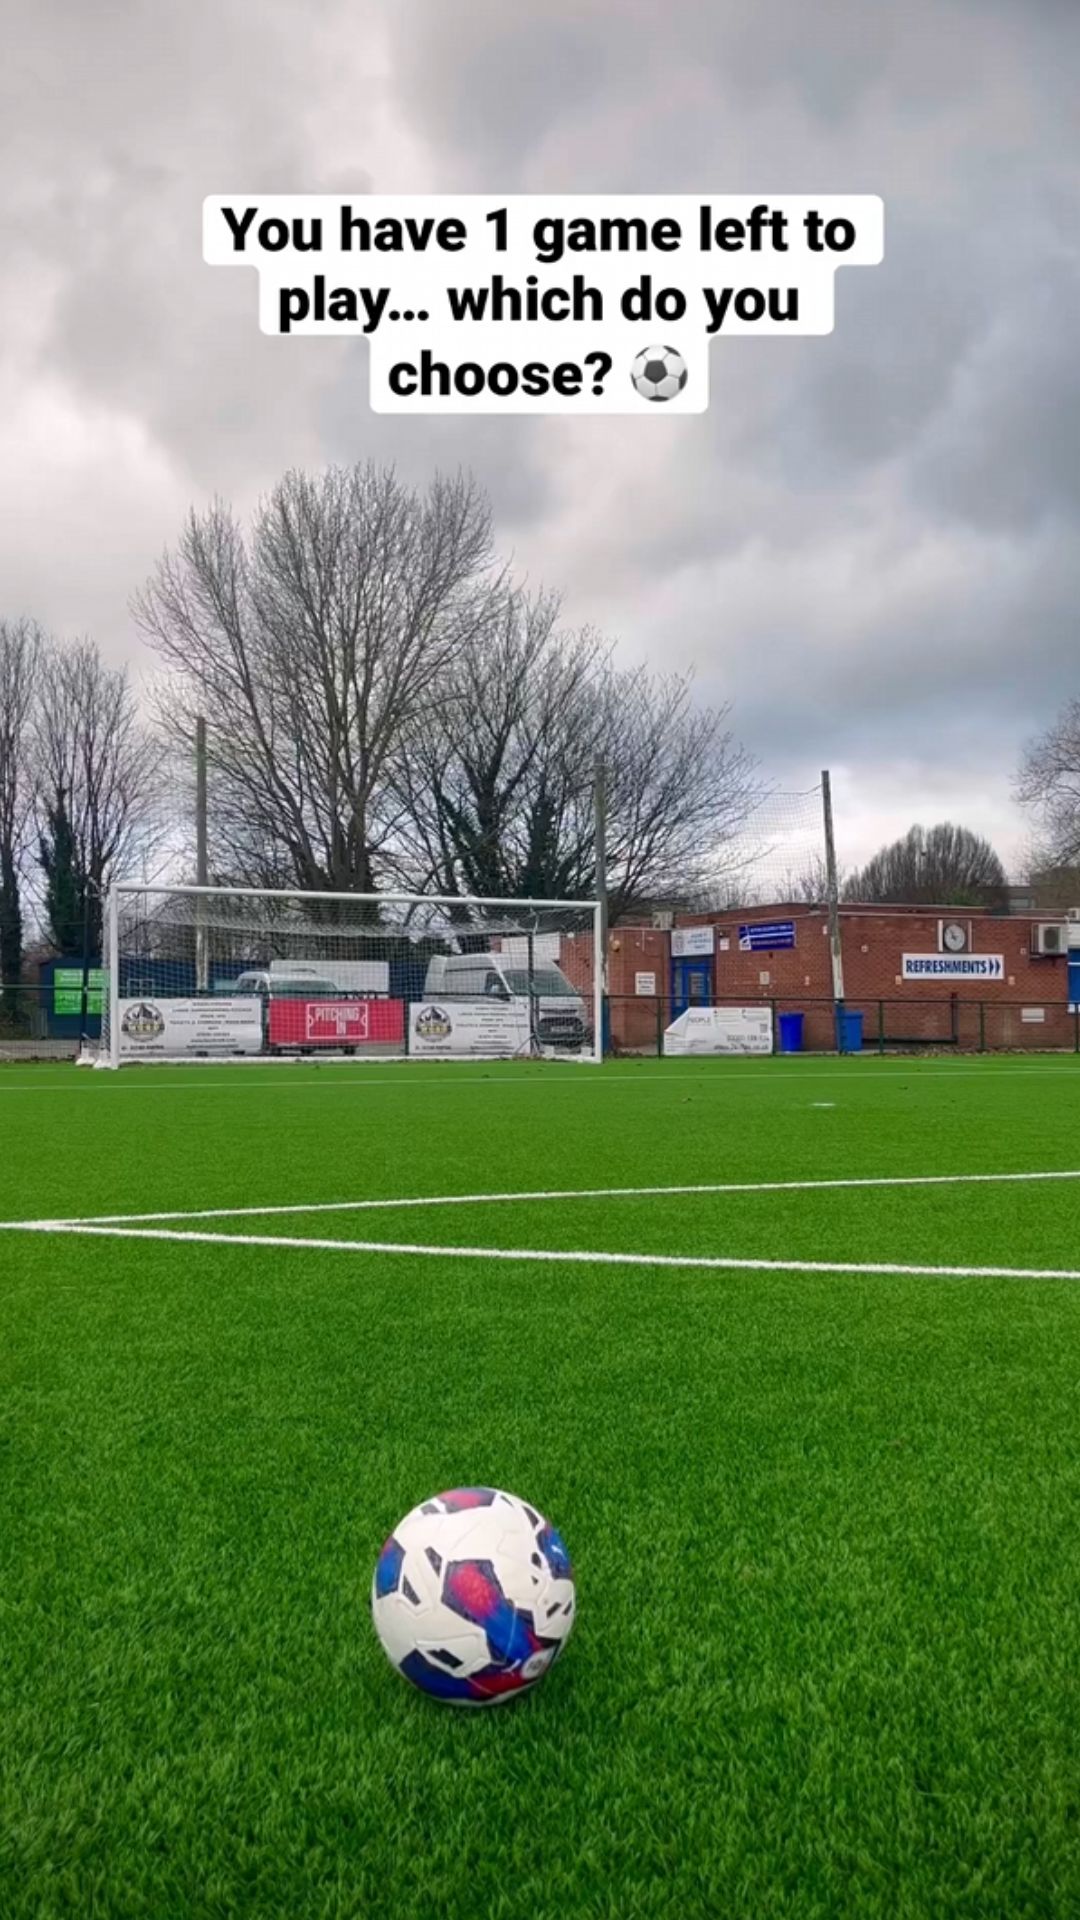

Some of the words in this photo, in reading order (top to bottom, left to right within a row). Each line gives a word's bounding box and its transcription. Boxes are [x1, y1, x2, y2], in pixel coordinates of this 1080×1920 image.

[906, 960, 987, 973] REFRESHMENTS
[315, 1007, 359, 1021] PITCHING
[337, 1021, 346, 1034] IN
